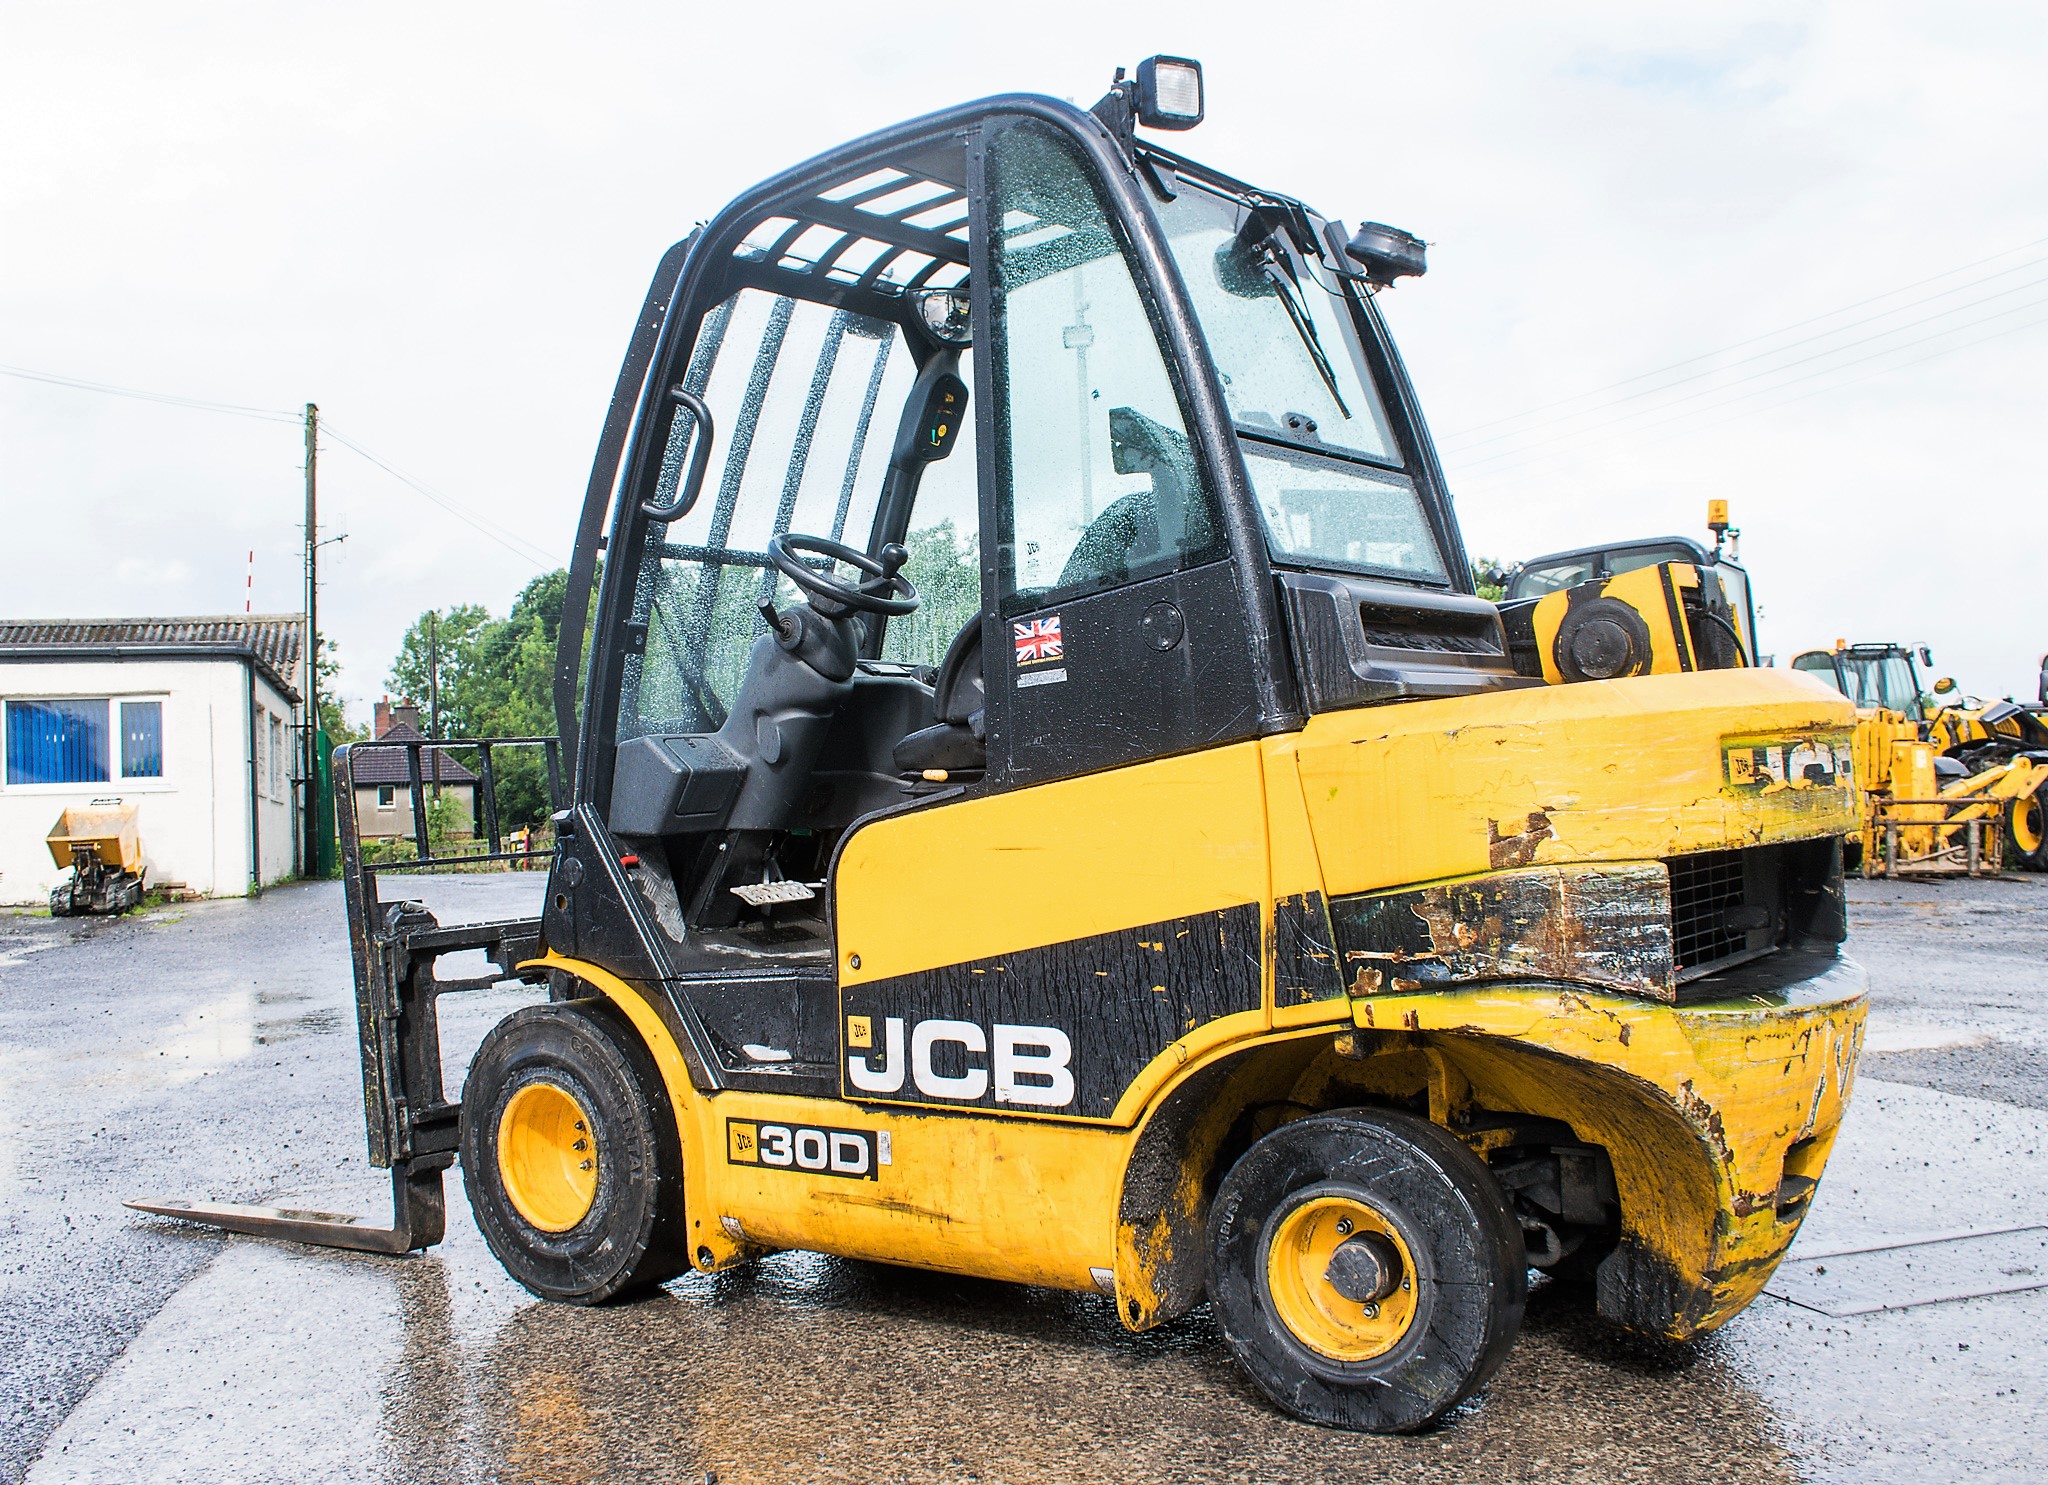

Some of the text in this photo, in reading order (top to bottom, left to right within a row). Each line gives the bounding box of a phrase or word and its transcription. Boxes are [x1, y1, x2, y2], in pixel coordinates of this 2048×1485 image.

[848, 1016, 1075, 1107] JCB
[736, 1132, 753, 1151] JCB
[760, 1125, 870, 1175] 30D
